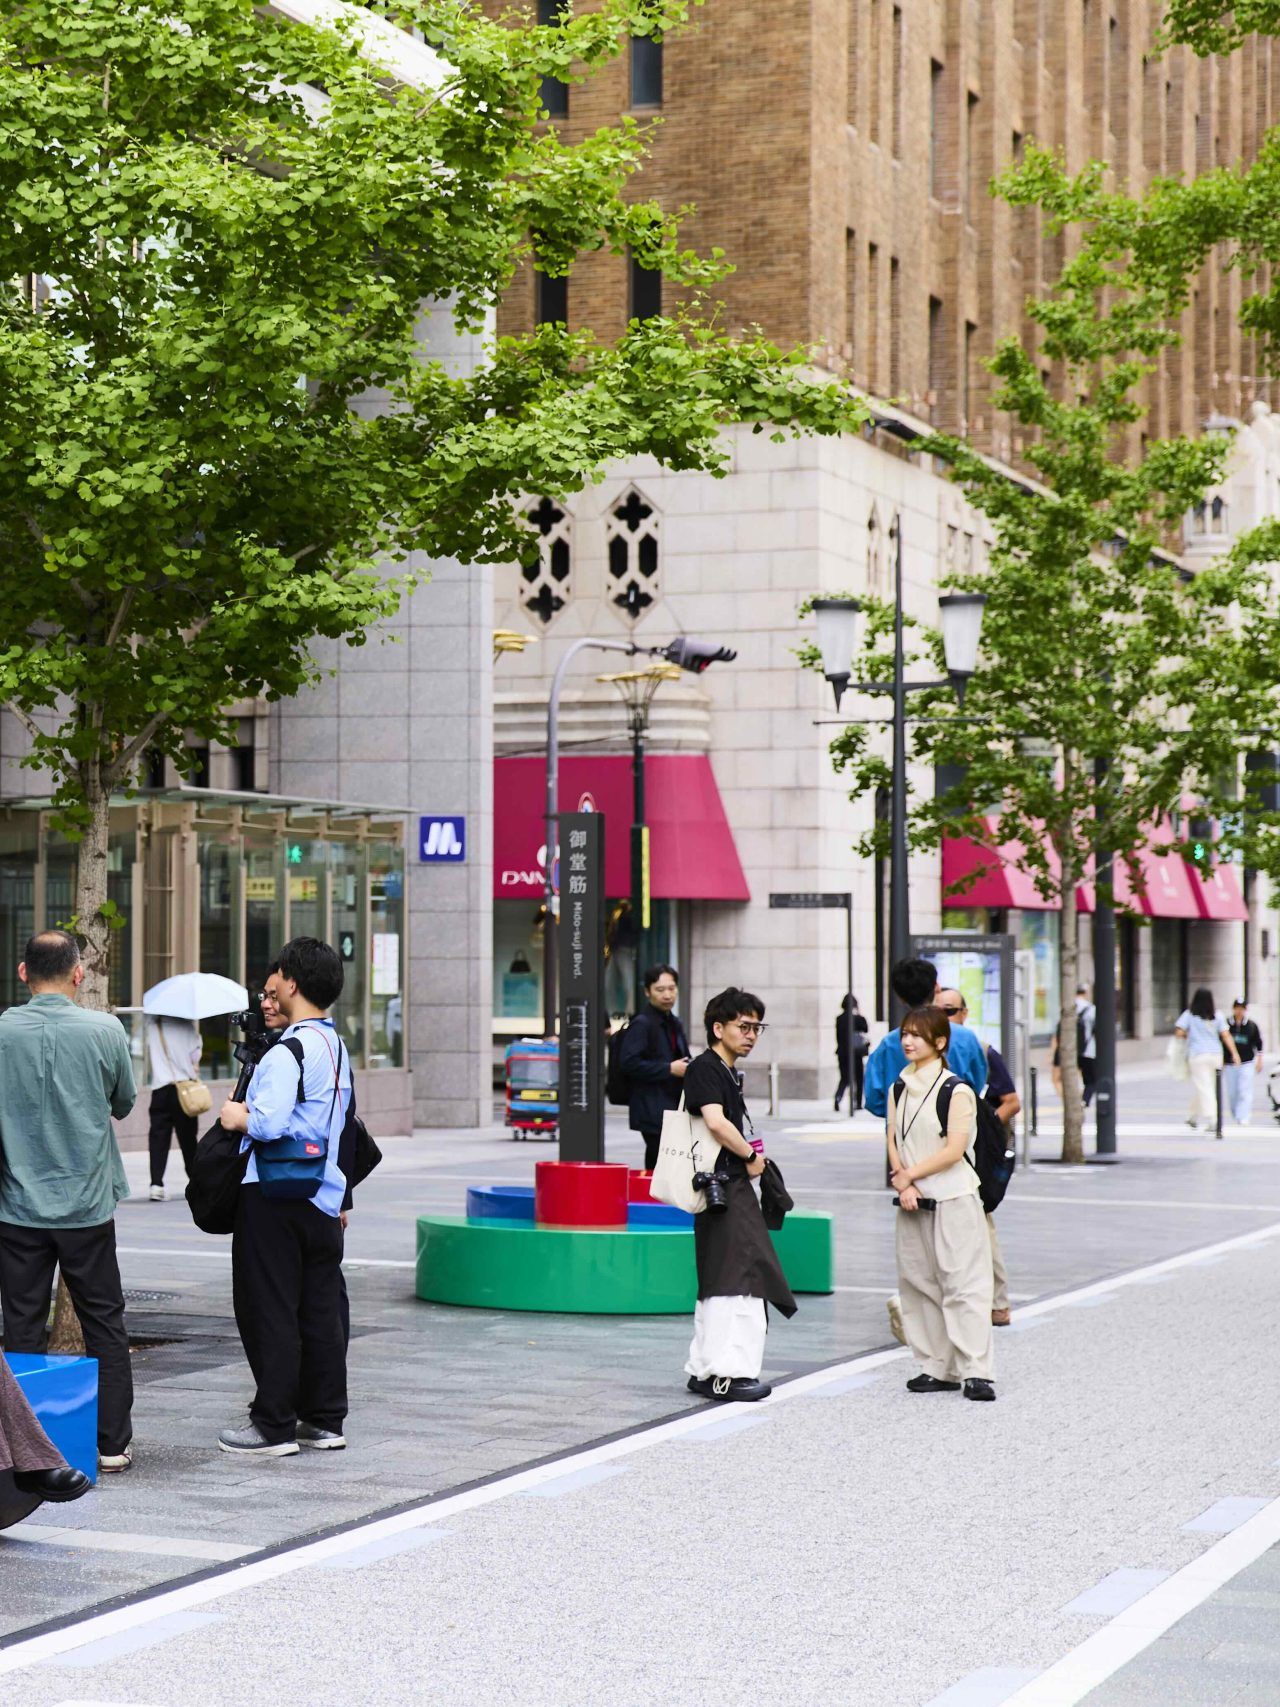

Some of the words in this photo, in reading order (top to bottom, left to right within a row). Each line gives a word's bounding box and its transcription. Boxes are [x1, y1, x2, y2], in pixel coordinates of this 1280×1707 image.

[569, 830, 587, 894] 御堂筋
[572, 902, 583, 950] Mido-suji
[573, 952, 583, 979] Blvd.
